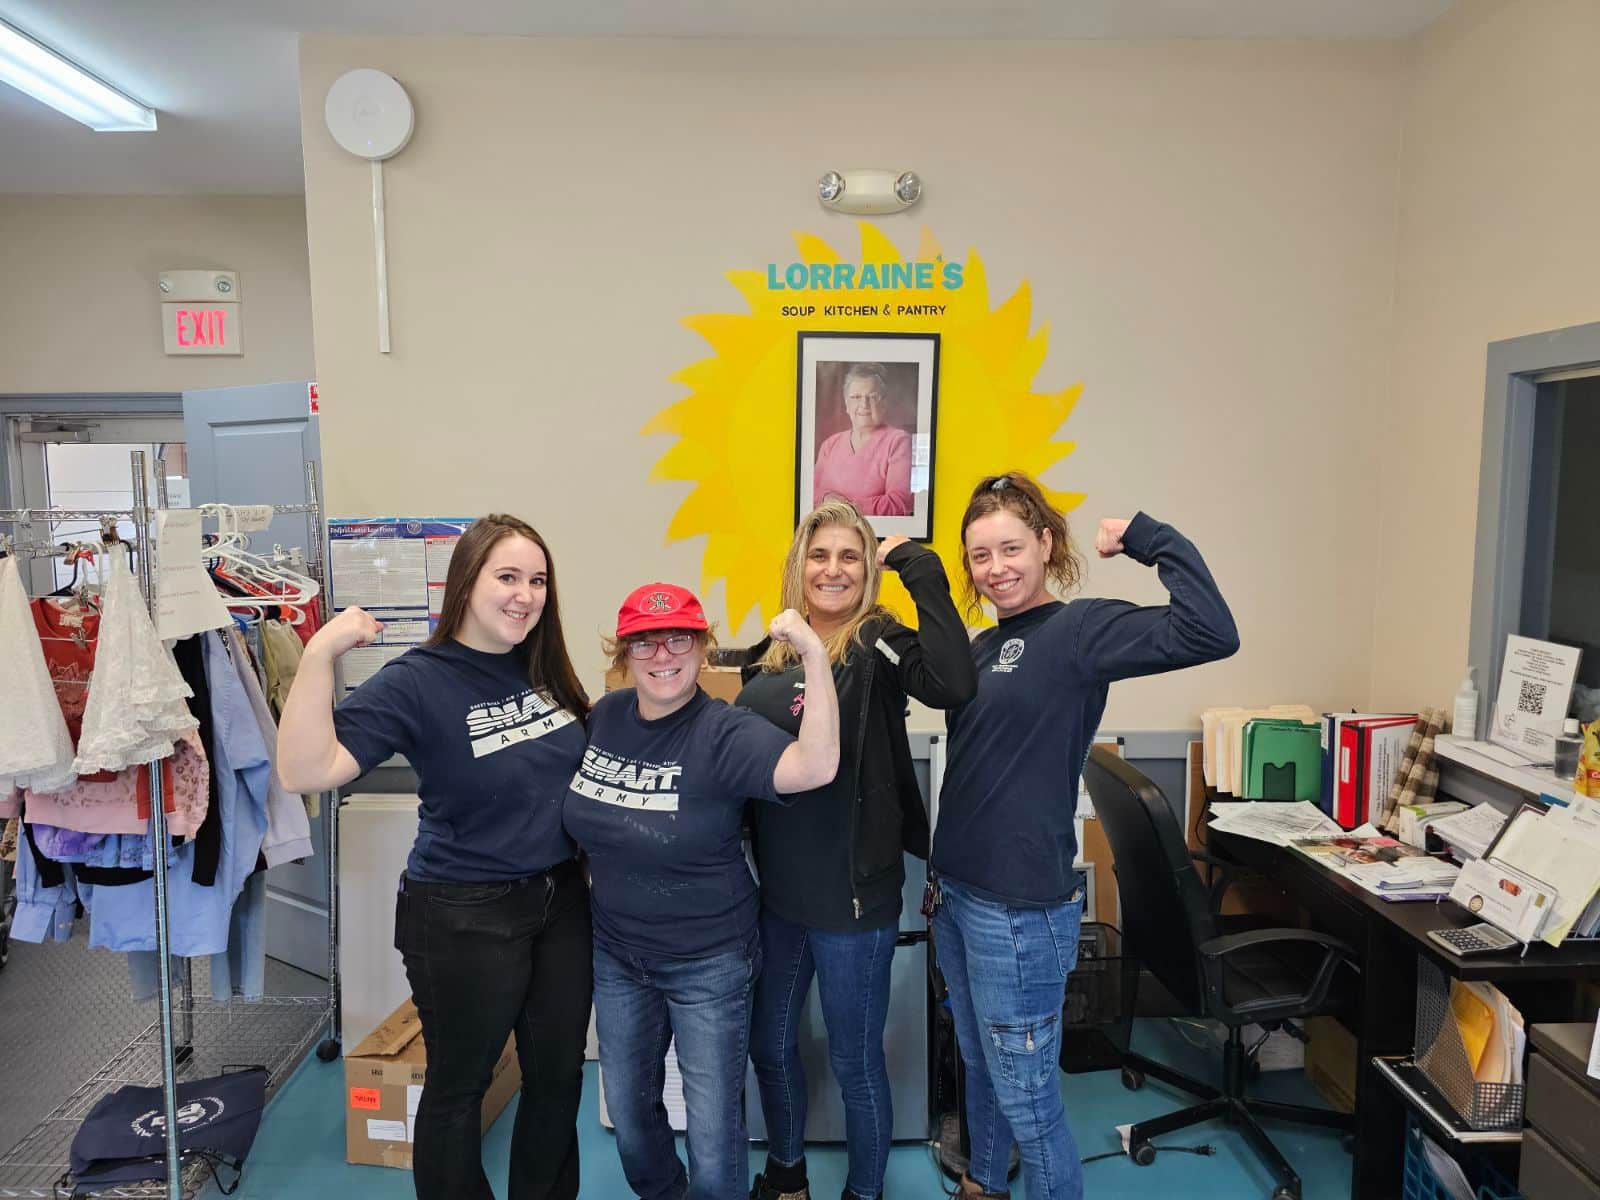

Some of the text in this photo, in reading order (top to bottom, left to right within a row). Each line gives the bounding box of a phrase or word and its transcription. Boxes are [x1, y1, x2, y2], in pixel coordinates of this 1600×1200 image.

[767, 254, 964, 290] LORRAINE'S
[781, 303, 947, 317] SOUP KITCHEN & PANTRY
[176, 310, 227, 347] EXIT
[581, 749, 682, 791] SMART
[576, 781, 650, 807] ARMY
